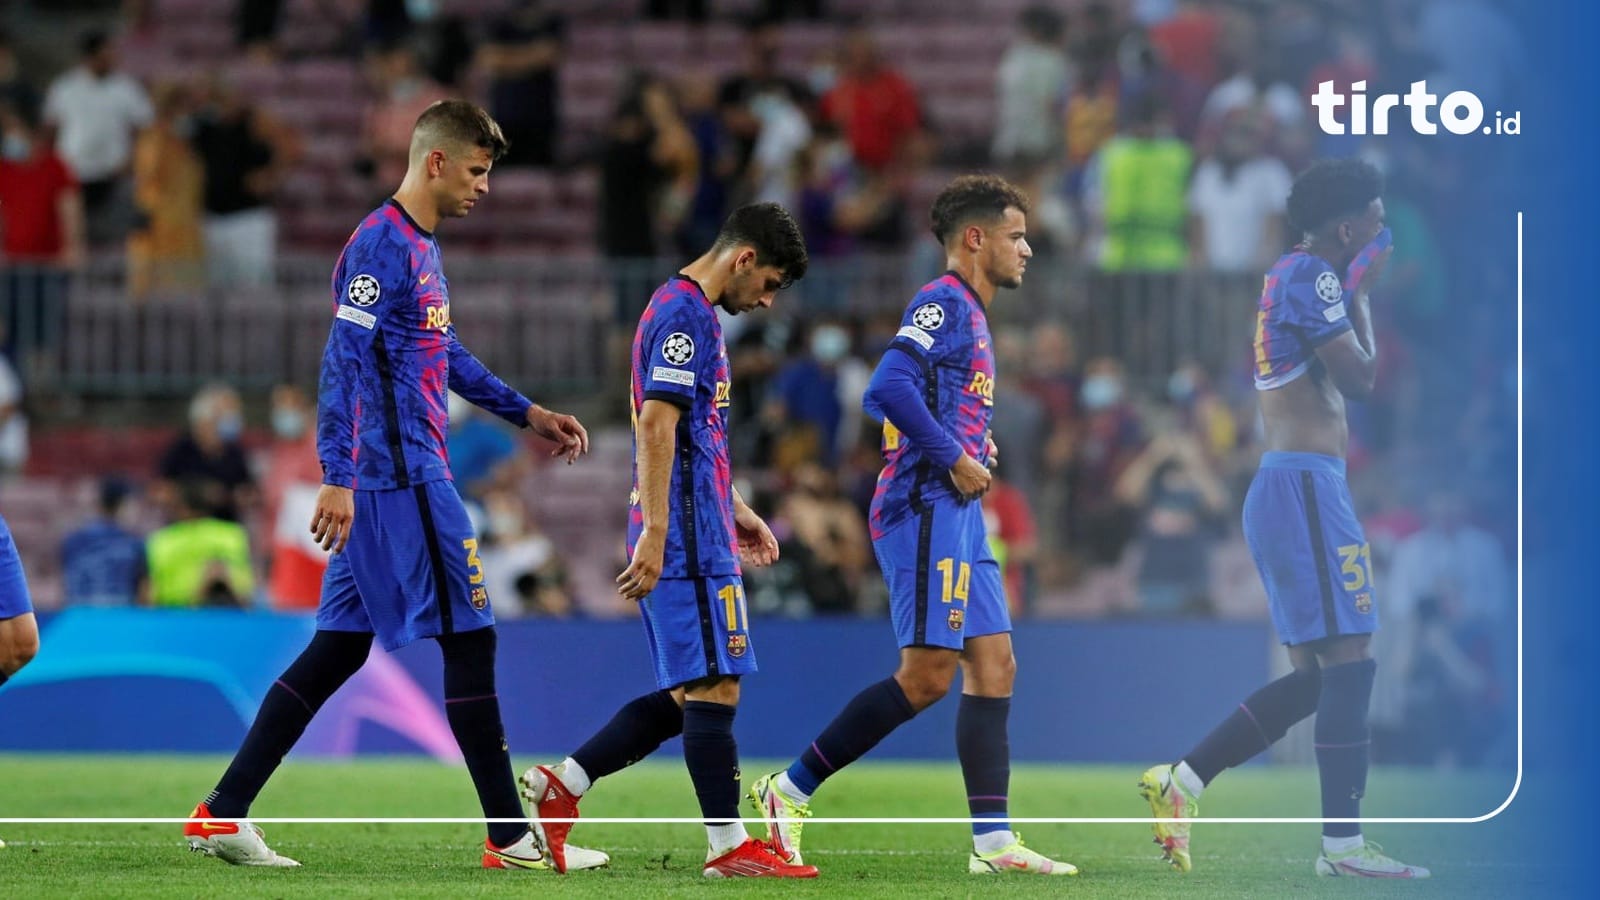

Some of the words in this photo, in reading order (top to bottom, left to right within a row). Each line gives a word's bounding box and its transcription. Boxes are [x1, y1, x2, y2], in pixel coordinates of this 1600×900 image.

[463, 538, 484, 584] 3
[936, 557, 971, 608] 14
[1337, 542, 1375, 591] 31
[717, 584, 749, 631] 11
